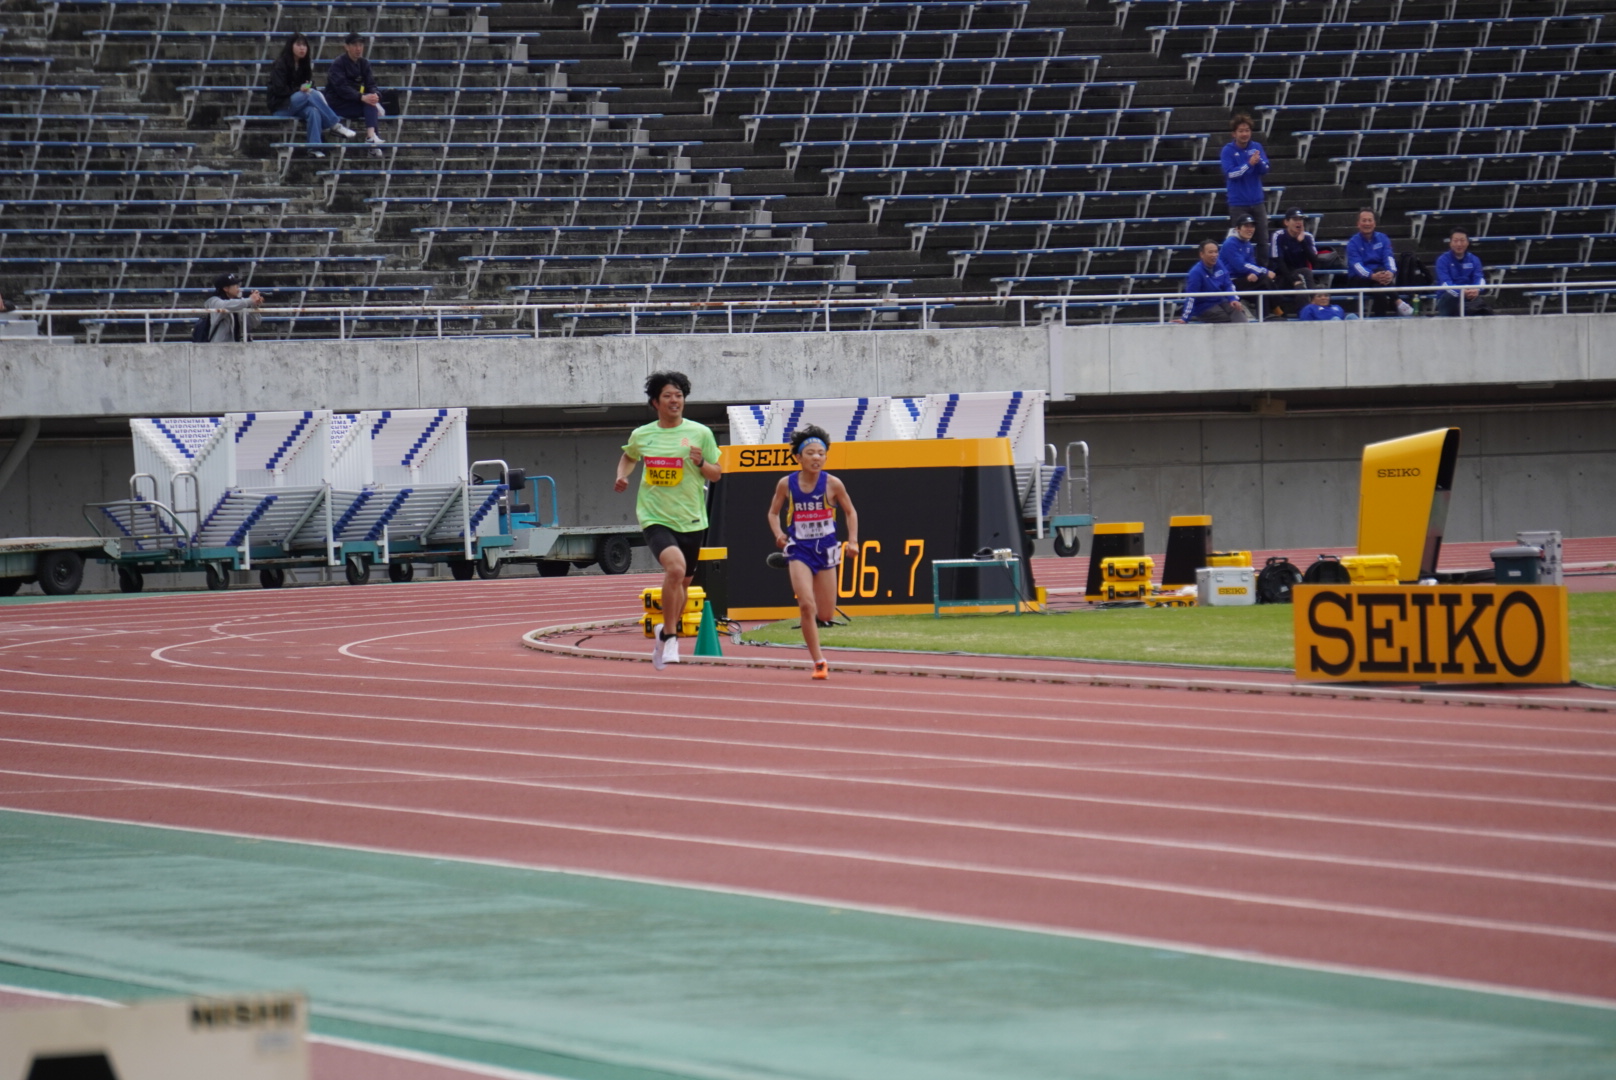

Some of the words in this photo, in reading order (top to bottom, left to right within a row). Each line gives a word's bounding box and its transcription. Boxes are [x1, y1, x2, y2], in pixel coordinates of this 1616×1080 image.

[739, 449, 799, 467] SEIK
[649, 469, 677, 480] PACER
[1377, 467, 1421, 478] SEIKO
[794, 501, 823, 511] RISE
[1218, 587, 1248, 595] SEIKO
[1308, 590, 1546, 677] SEIKO
